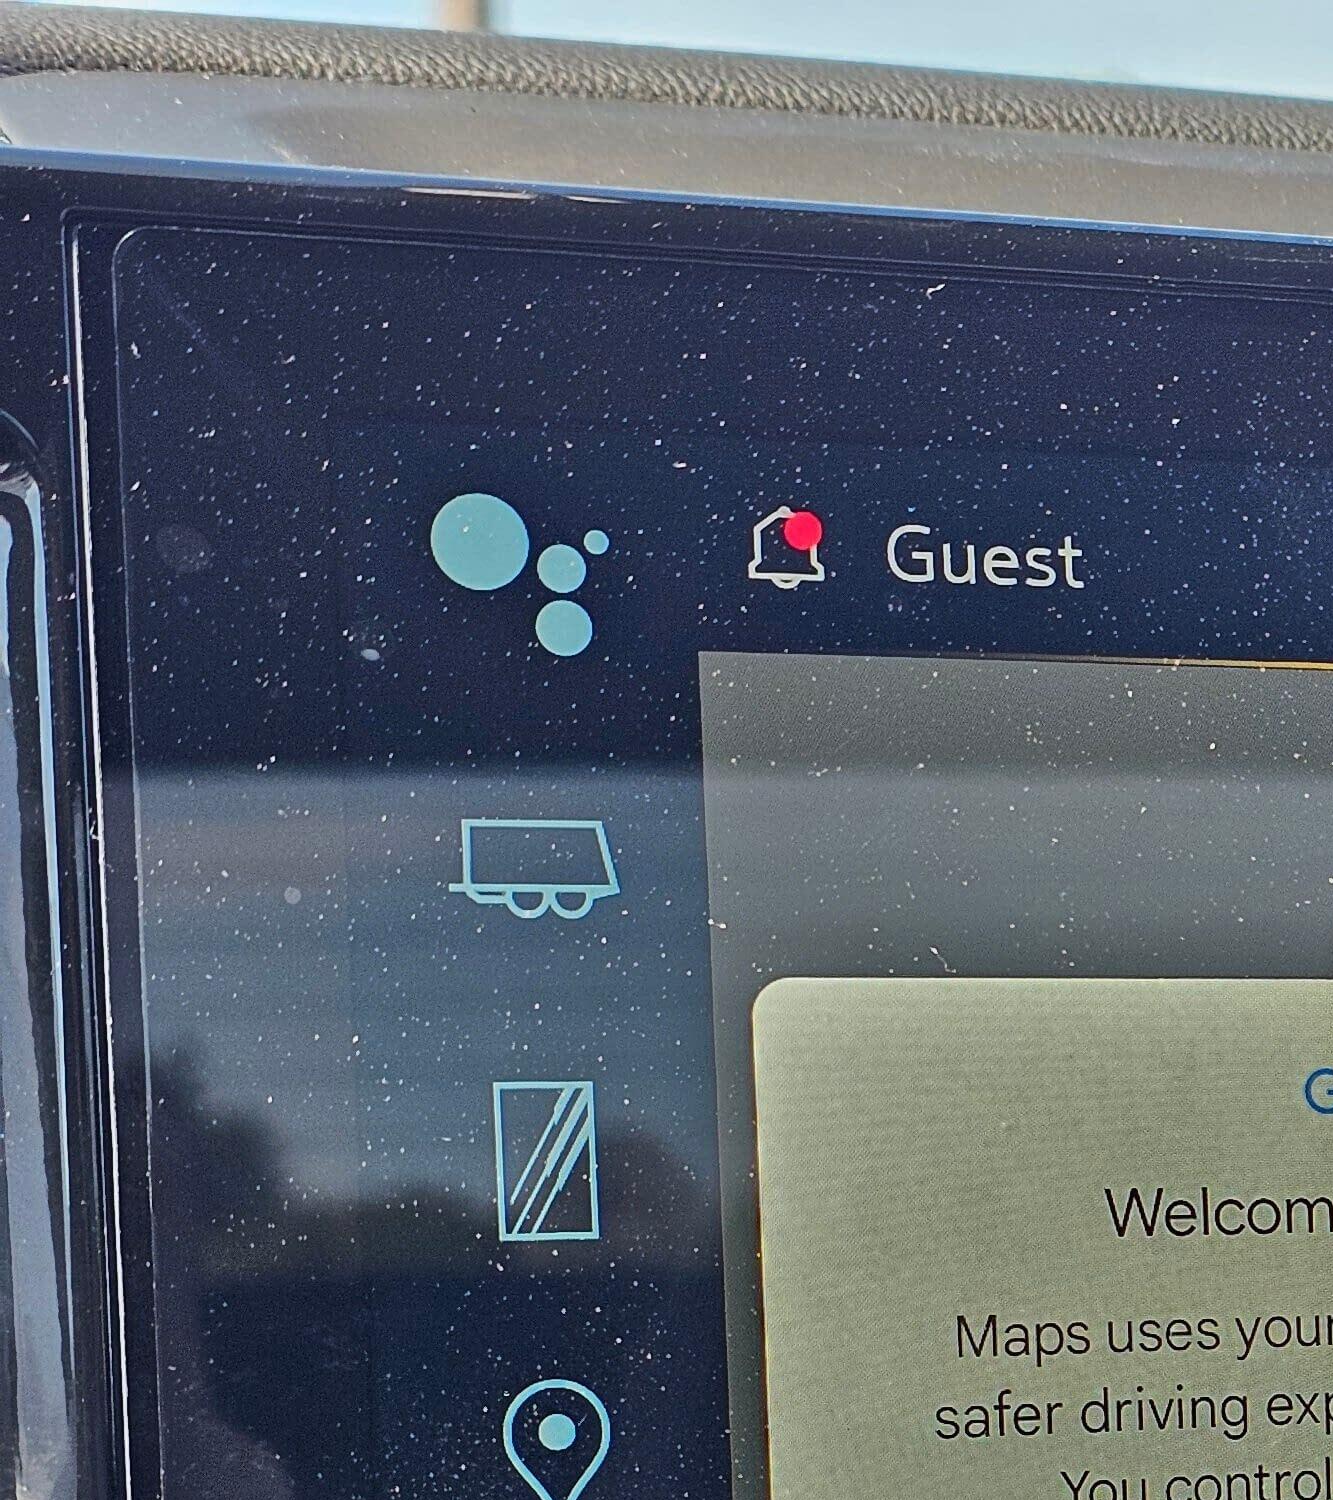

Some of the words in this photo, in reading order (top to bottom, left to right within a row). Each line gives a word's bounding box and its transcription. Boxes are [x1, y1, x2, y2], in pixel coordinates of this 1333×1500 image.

[886, 524, 1085, 589] Guest
[956, 1314, 1091, 1368] Maps
[1107, 1316, 1221, 1354] uses
[935, 1389, 1064, 1439] safer
[1081, 1384, 1249, 1440] driving
